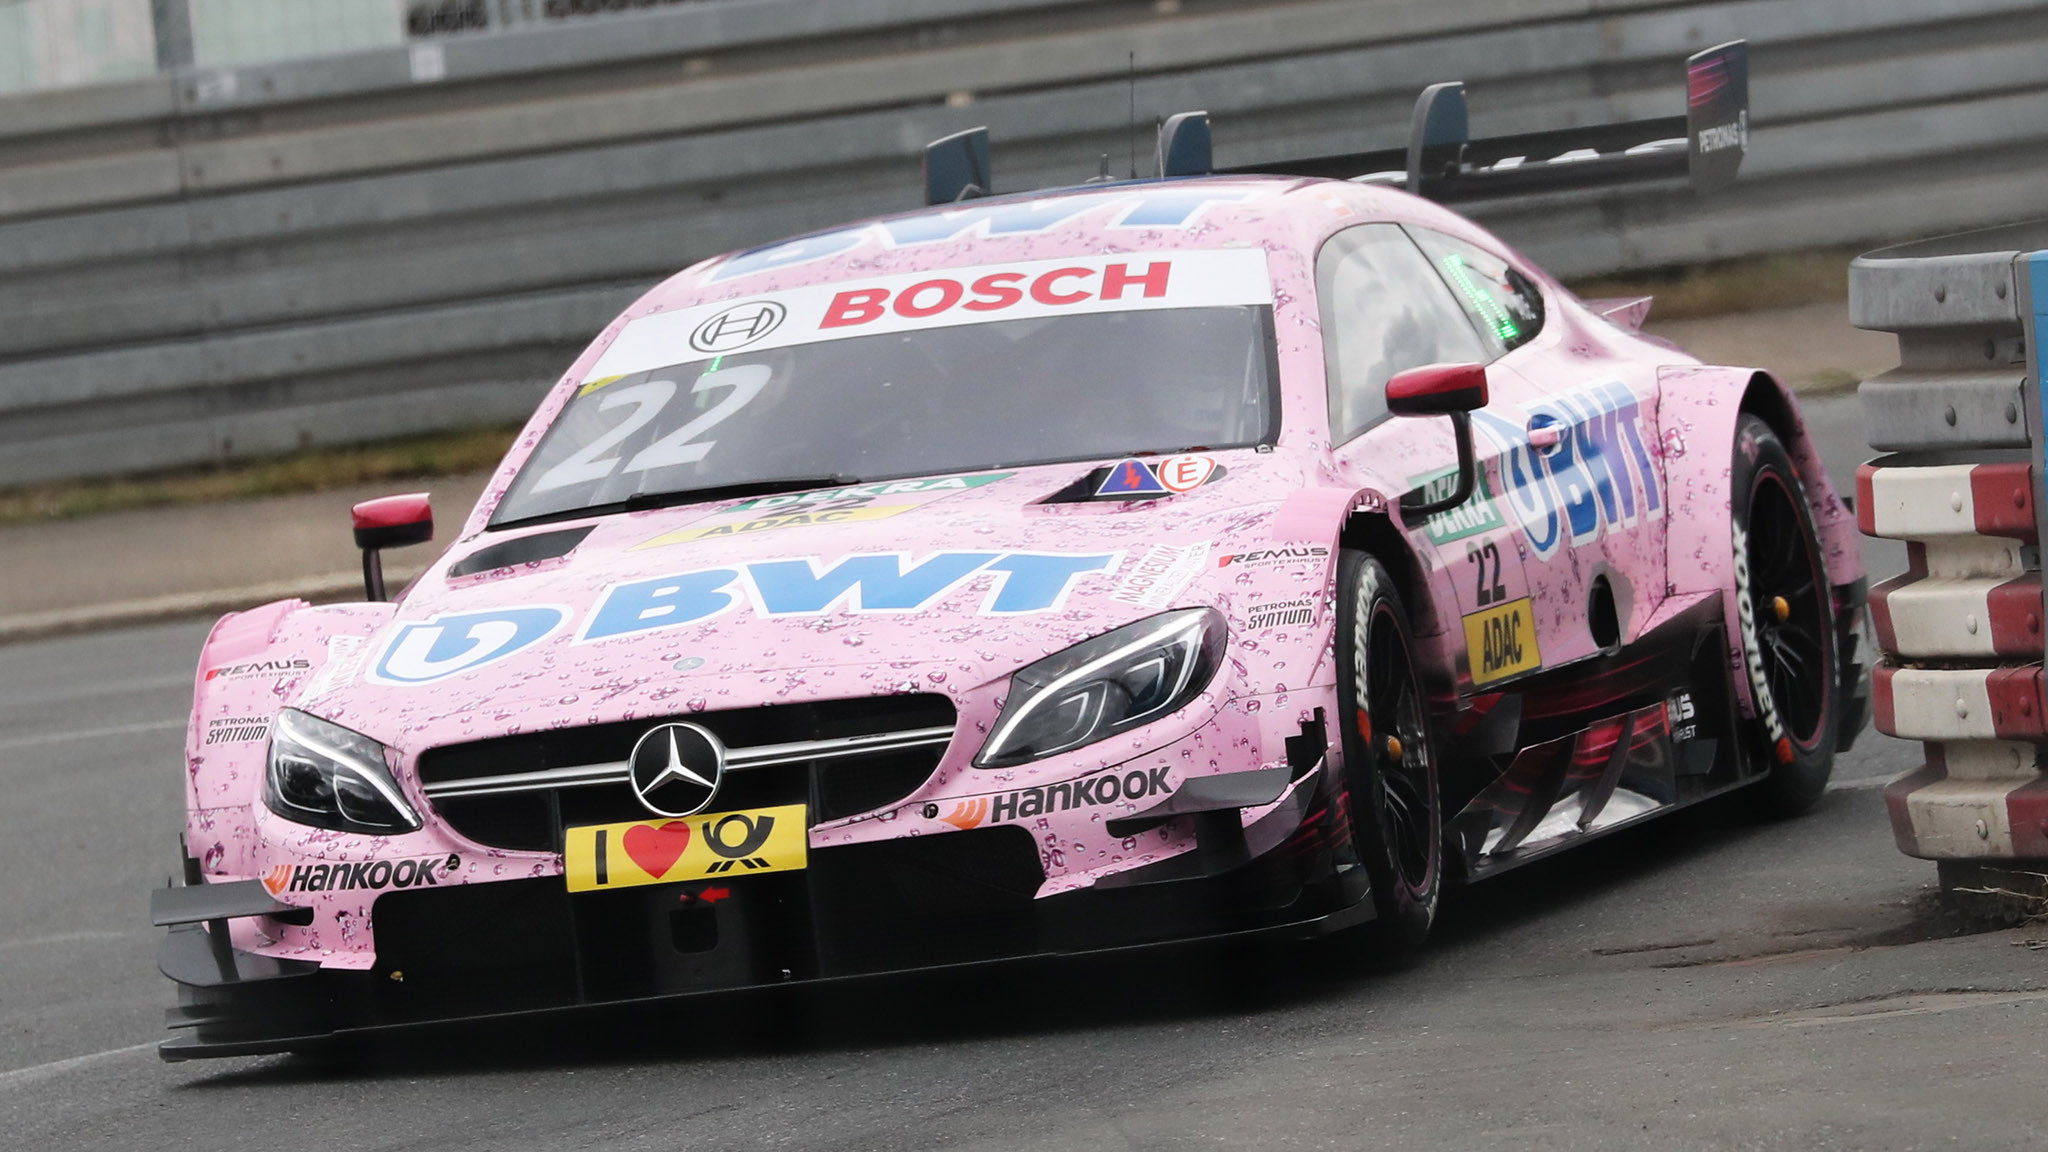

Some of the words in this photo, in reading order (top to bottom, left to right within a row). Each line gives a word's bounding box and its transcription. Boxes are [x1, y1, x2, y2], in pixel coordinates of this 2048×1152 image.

[711, 189, 1250, 281] BWT
[818, 261, 1172, 330] BOSCH
[529, 363, 773, 494] 22
[1526, 379, 1663, 540] BWT
[749, 477, 967, 511] DEKRA
[694, 510, 854, 539] ADAC
[1115, 545, 1185, 603] MAGNESIUM
[1229, 547, 1330, 565] REMUS
[1466, 537, 1506, 606] 22
[575, 550, 1122, 644] BWT
[1248, 599, 1313, 614] PETRONAS
[1248, 609, 1313, 630] SYNTIUM
[1482, 610, 1523, 674] ADAC
[208, 659, 311, 678] REMUS
[206, 725, 268, 745] SYNTIUM
[209, 716, 270, 727] PETRONAS
